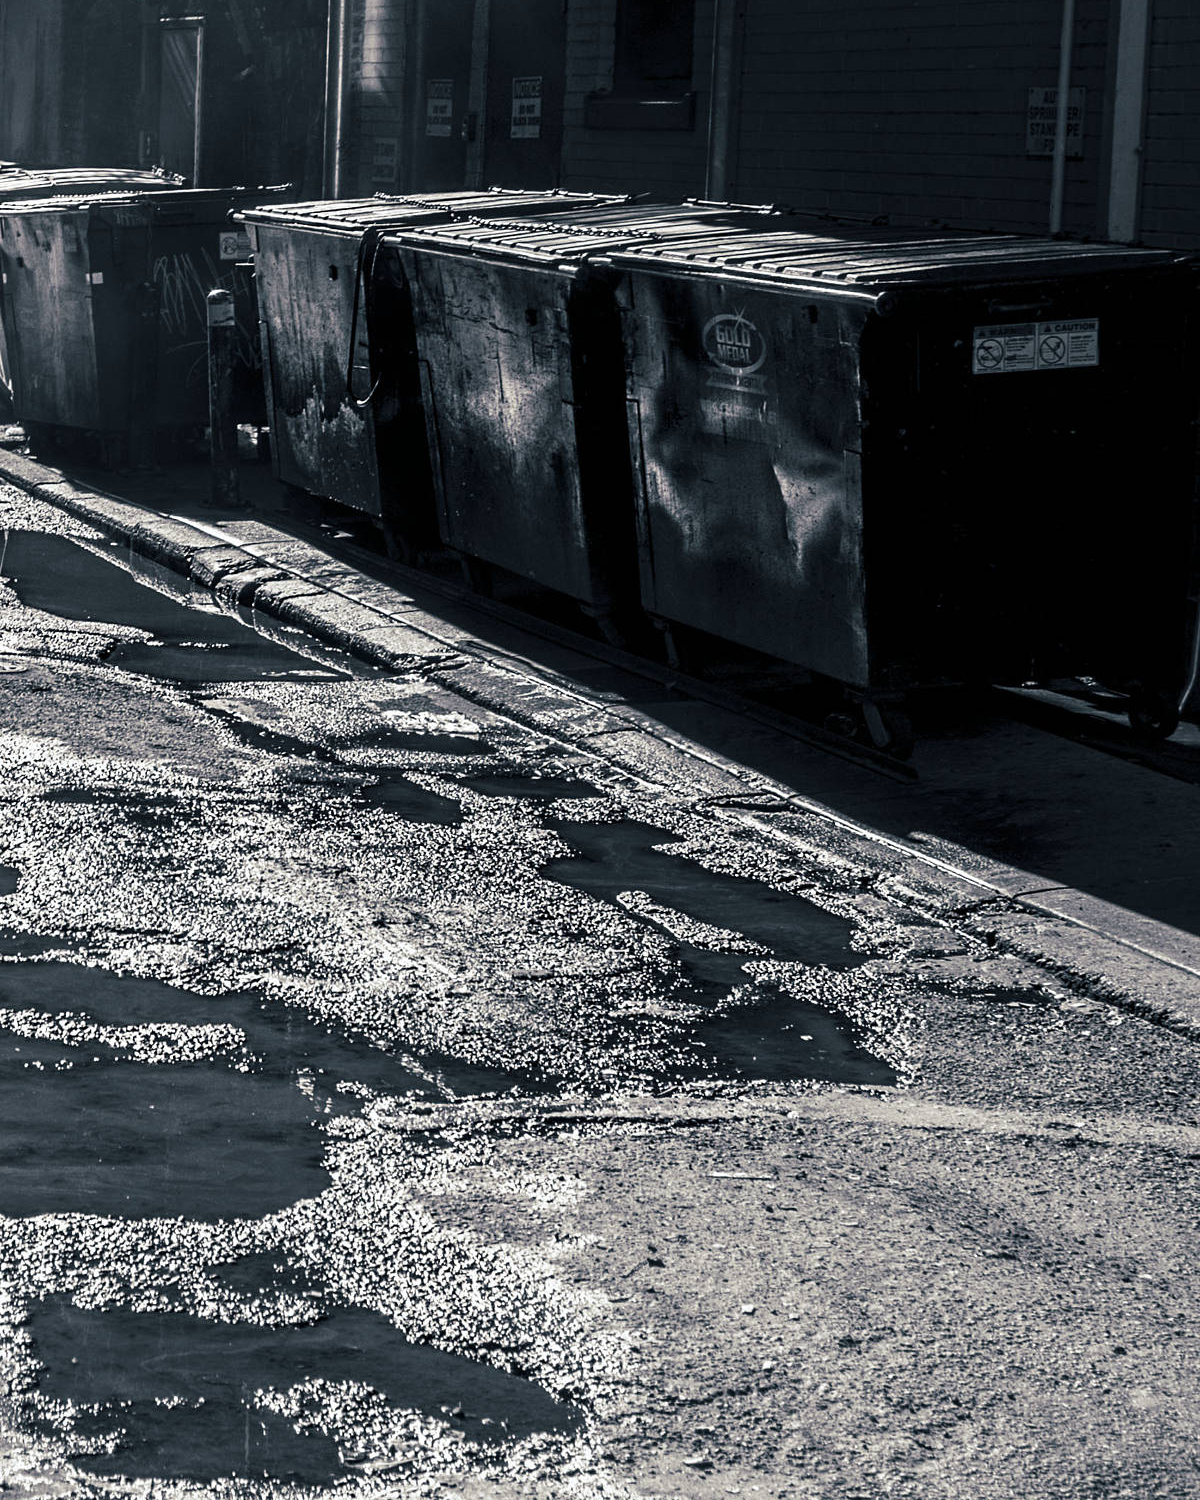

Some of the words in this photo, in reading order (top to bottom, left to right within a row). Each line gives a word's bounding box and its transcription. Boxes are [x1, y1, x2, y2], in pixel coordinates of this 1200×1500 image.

[715, 325, 751, 348] GOLD
[1054, 322, 1096, 333] CAUTION
[716, 344, 752, 364] MEDAL
